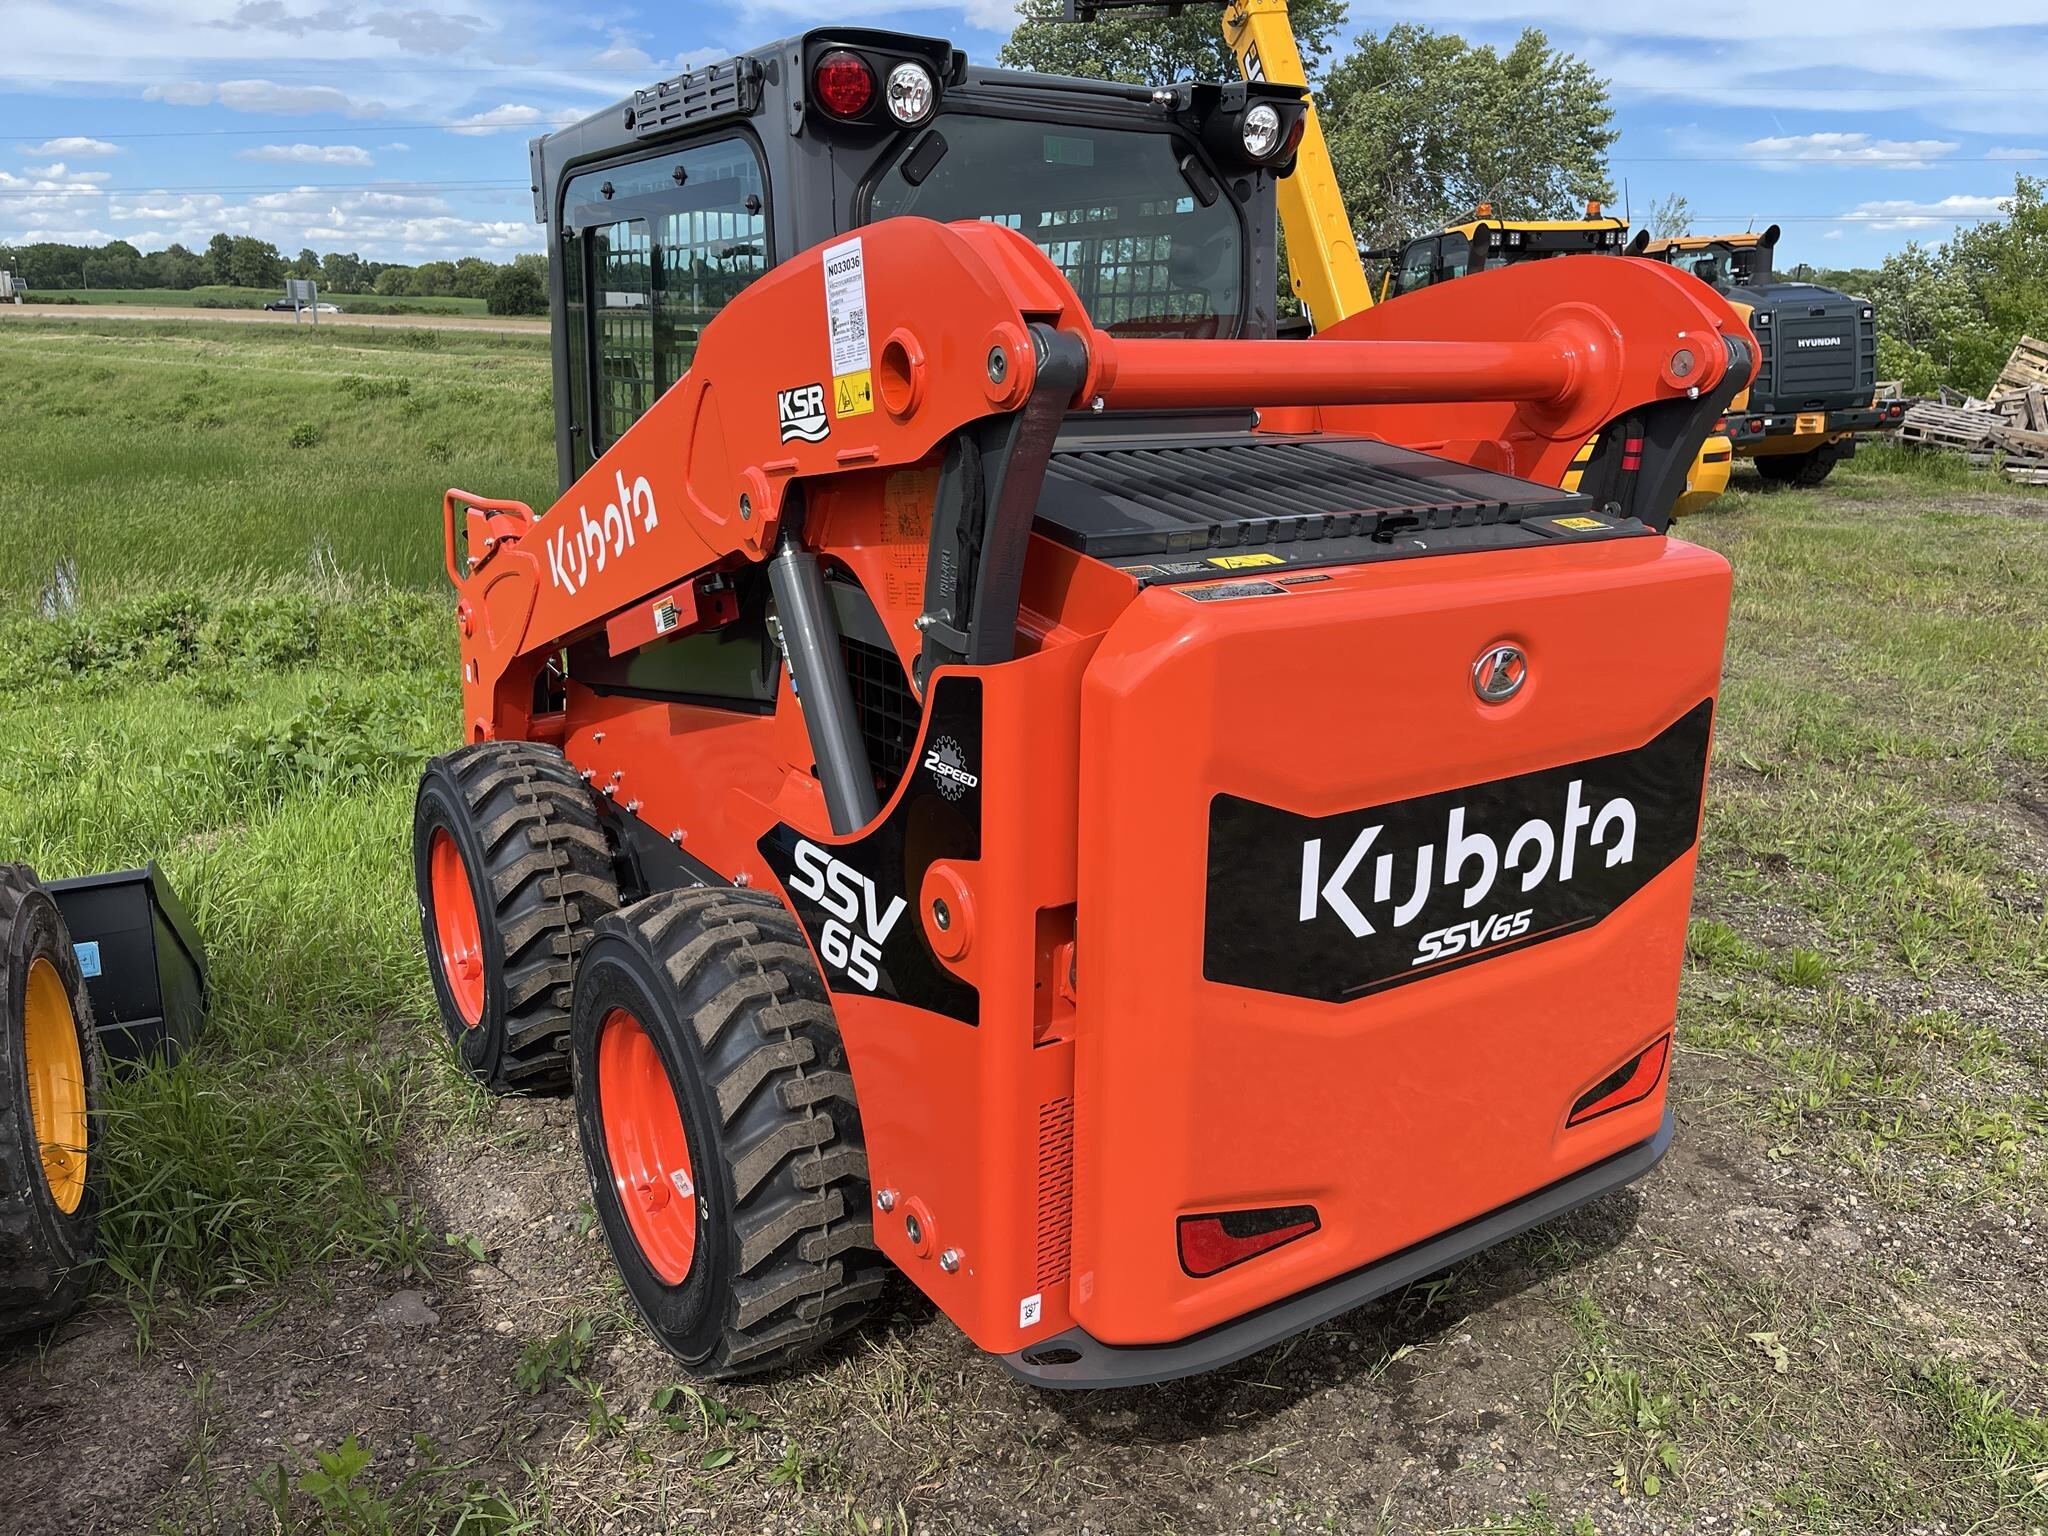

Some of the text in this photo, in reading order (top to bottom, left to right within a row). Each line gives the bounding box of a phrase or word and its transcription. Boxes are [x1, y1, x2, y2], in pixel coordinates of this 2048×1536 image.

[828, 255, 861, 277] N033036
[1797, 337, 1841, 348] HYUNDAI
[778, 385, 825, 421] KSR
[546, 469, 659, 596] Kubota
[1299, 779, 1637, 938] Kubota
[789, 839, 908, 945] SSV
[820, 919, 882, 992] 65
[1411, 908, 1534, 966] SSV65
